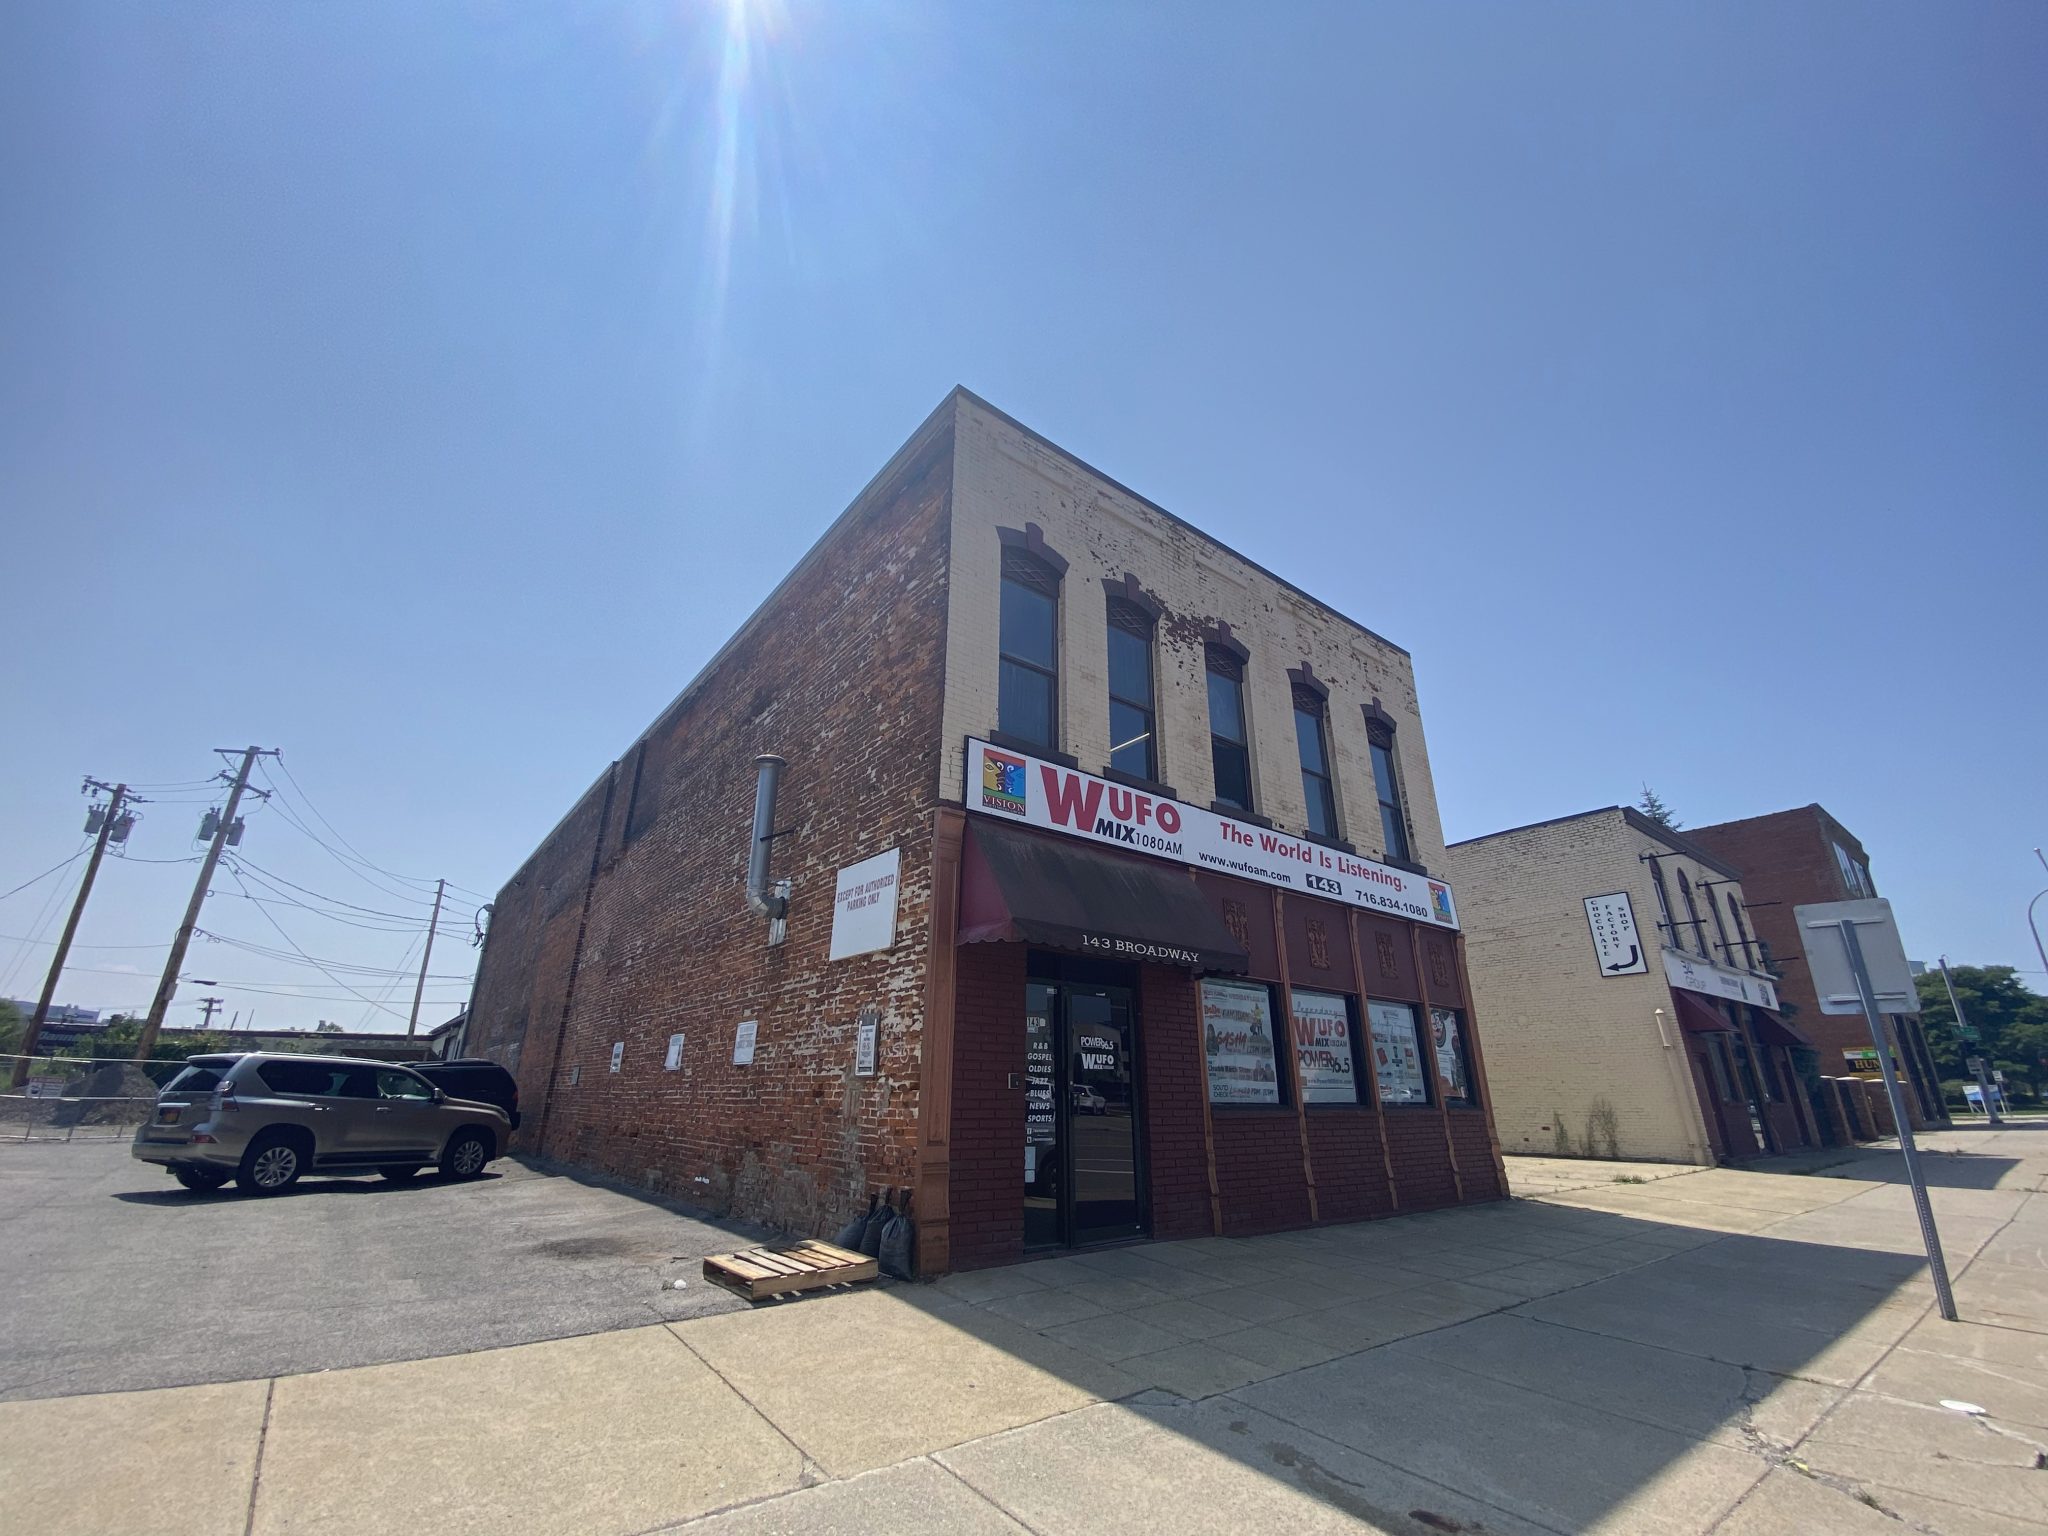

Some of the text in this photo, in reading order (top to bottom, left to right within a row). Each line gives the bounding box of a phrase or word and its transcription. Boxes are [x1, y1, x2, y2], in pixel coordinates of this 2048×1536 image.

[983, 794, 1025, 812] VISION
[1040, 765, 1181, 834] WUFO
[1198, 851, 1291, 883] www.wufoam.com
[1220, 822, 1408, 892] The World Is Listening.
[837, 874, 894, 903] EXCEPT FOR AUTHORIZED
[1308, 874, 1341, 895] 143
[846, 892, 880, 912] PARKING ONLY
[1355, 889, 1428, 917] 716.834.1080
[1590, 900, 1610, 956] CHOCOLATE
[1605, 904, 1620, 948] FACTORY
[1618, 907, 1629, 931] SHOP
[1082, 934, 1199, 962] 143 BROADWAY
[1293, 1016, 1346, 1046] WUFO
[1027, 1052, 1053, 1061] GOSPEL
[1081, 1053, 1115, 1069] WUFO
[1028, 1065, 1052, 1073] OLDIES
[1031, 1077, 1049, 1085] JAZZ
[1029, 1089, 1051, 1098] BLUES
[1029, 1102, 1051, 1110] NEWS
[1027, 1114, 1053, 1122] SPORTS
